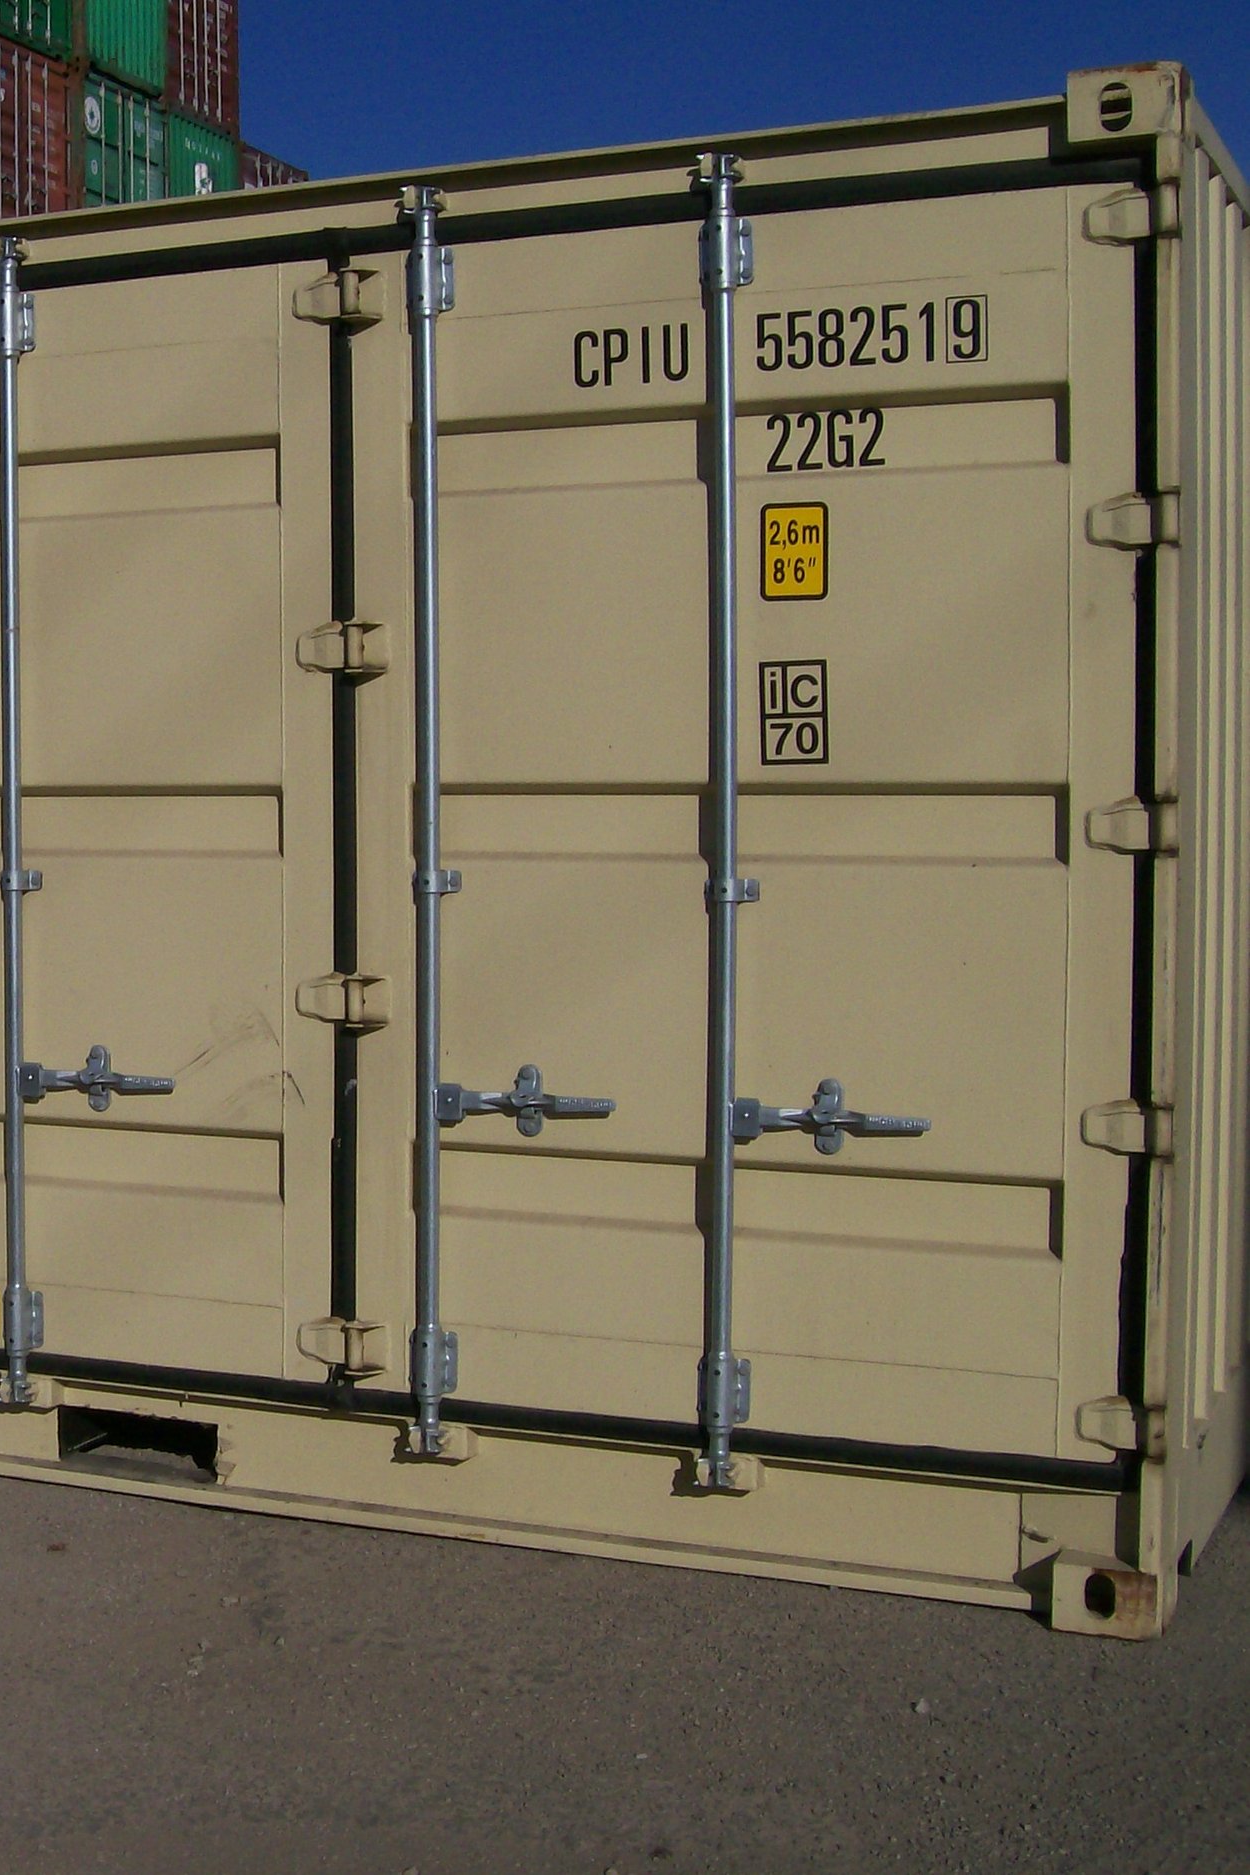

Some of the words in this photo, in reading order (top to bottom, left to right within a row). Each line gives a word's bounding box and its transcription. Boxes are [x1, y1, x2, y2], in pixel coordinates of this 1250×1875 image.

[573, 322, 689, 388] CPIU
[755, 298, 982, 372] 5582519
[766, 407, 887, 473] 22G2
[770, 722, 820, 756] 70
